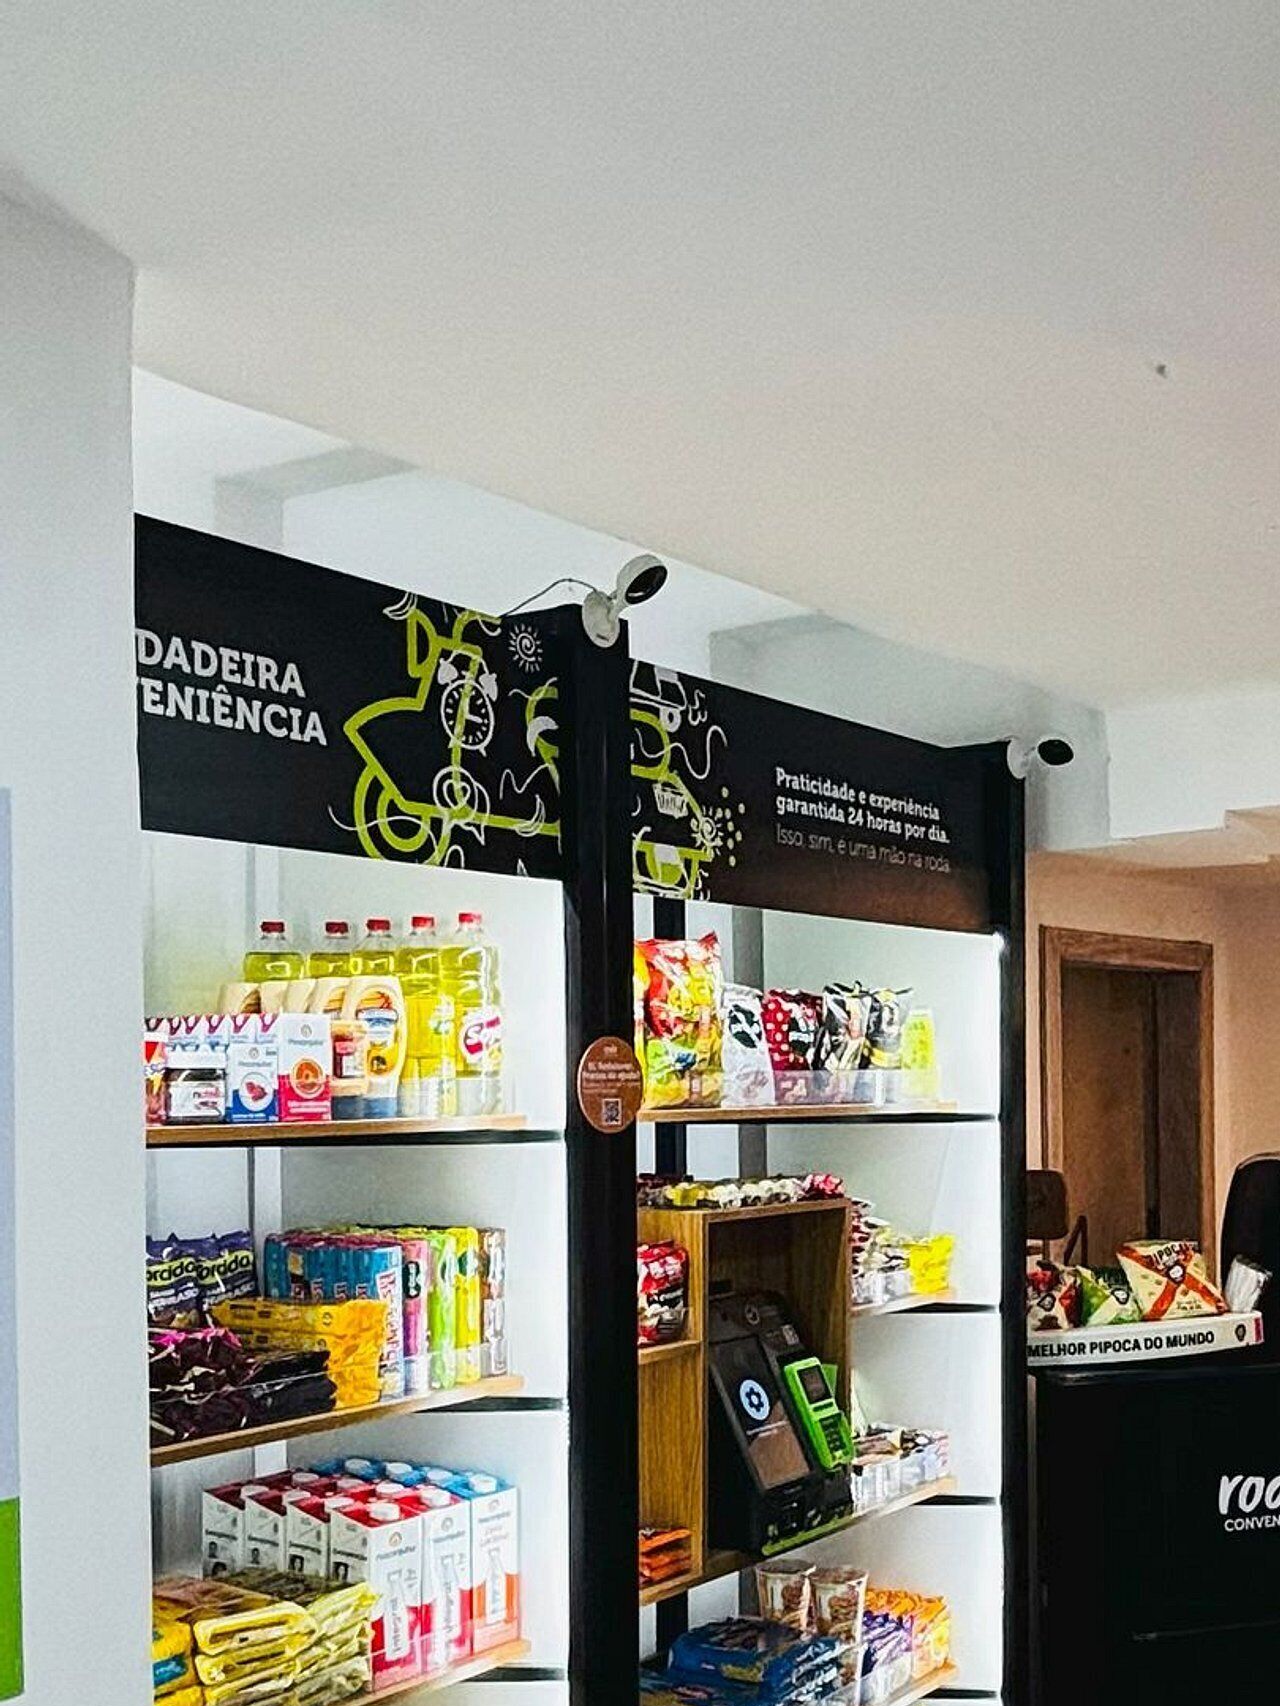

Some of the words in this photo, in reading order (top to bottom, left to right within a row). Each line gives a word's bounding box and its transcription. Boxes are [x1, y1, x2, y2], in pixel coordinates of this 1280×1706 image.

[135, 628, 306, 698] DADEIRA
[136, 676, 327, 746] ENIÊNCIA
[775, 766, 856, 802] Praticidade
[858, 790, 867, 805] e
[869, 793, 940, 821] experiência
[776, 795, 845, 824] garantida
[848, 806, 864, 827] 24
[867, 810, 901, 835] horas
[905, 824, 926, 841] por
[1027, 1343, 1087, 1358] MELHOR
[1089, 1338, 1142, 1355] PIPOCA
[1144, 1336, 1164, 1350] DO
[1166, 1331, 1215, 1349] MUNDO
